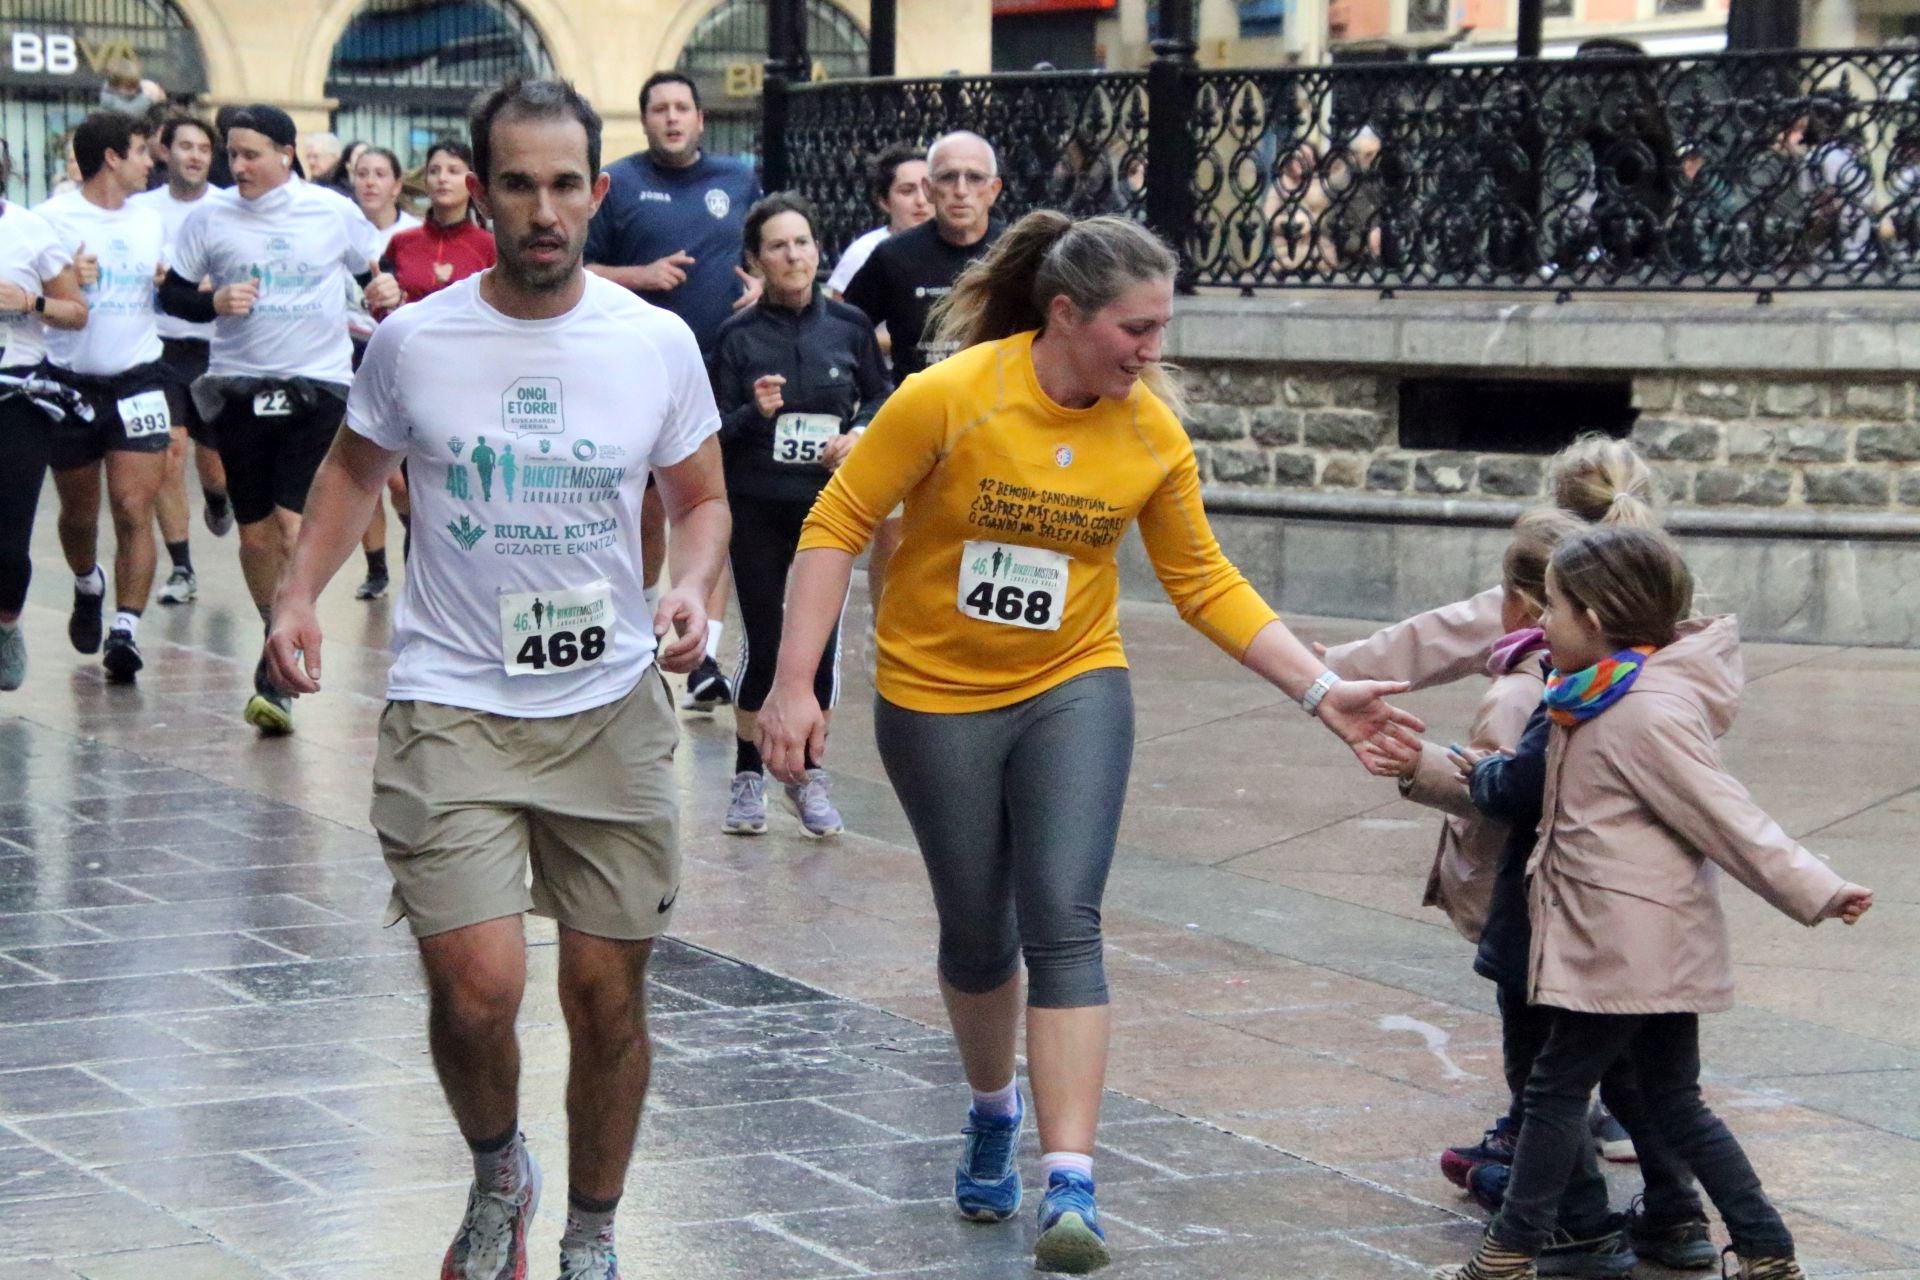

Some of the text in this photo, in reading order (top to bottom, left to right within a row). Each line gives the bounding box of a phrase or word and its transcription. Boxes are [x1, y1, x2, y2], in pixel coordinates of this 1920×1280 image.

[12, 32, 143, 74] BBVA
[517, 387, 547, 400] ONGI
[131, 412, 167, 433] 393
[979, 478, 996, 492] 42
[968, 511, 977, 524] O
[494, 517, 618, 540] RURAL KUTXA
[494, 534, 617, 556] GIZARTE EKINTZA
[970, 557, 989, 577] 46.
[966, 582, 1052, 625] 468
[513, 612, 532, 632] 46.
[517, 625, 606, 670] 468
